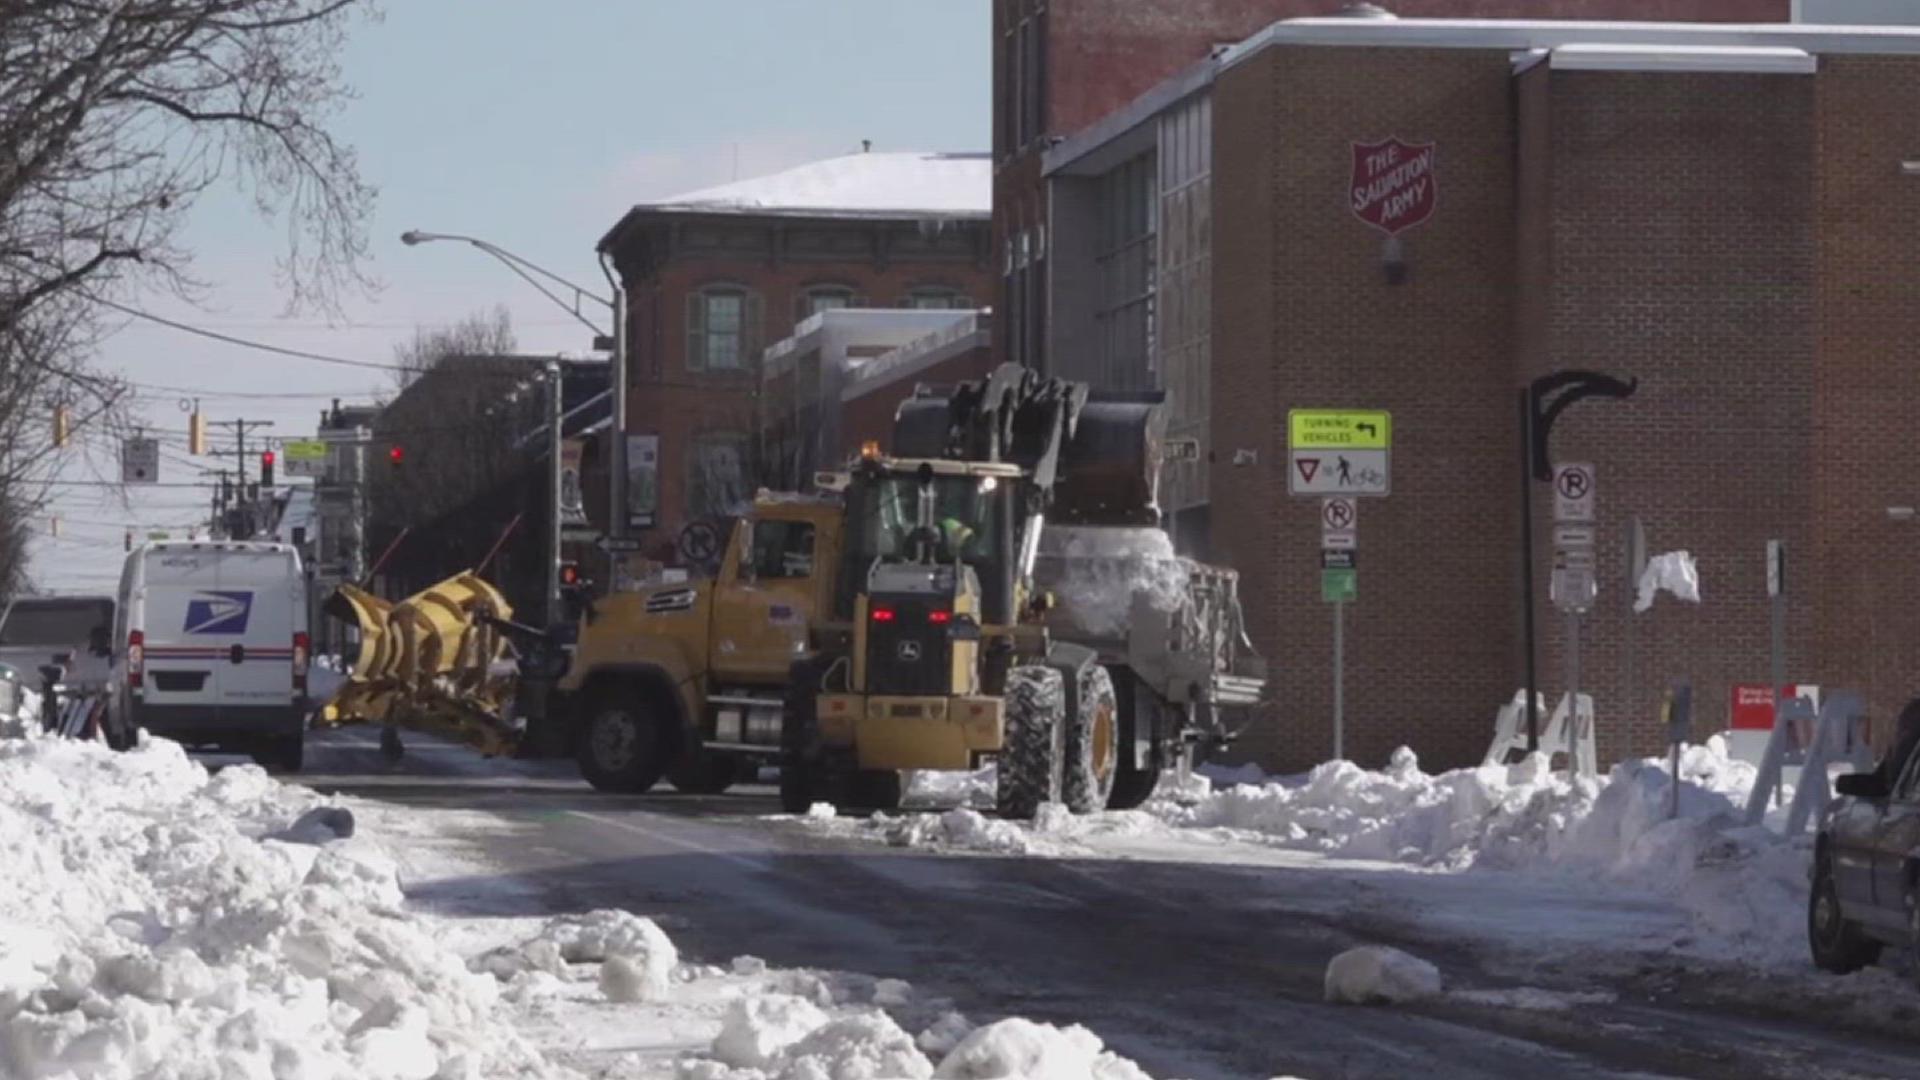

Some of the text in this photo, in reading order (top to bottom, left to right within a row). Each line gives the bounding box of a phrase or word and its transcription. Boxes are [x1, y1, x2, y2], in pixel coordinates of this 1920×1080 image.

[1366, 145, 1400, 177] THE
[1354, 148, 1430, 211] SALVATION
[1381, 178, 1427, 224] ARMY
[1303, 418, 1350, 429] TURNING
[1303, 432, 1352, 443] VEHICLES
